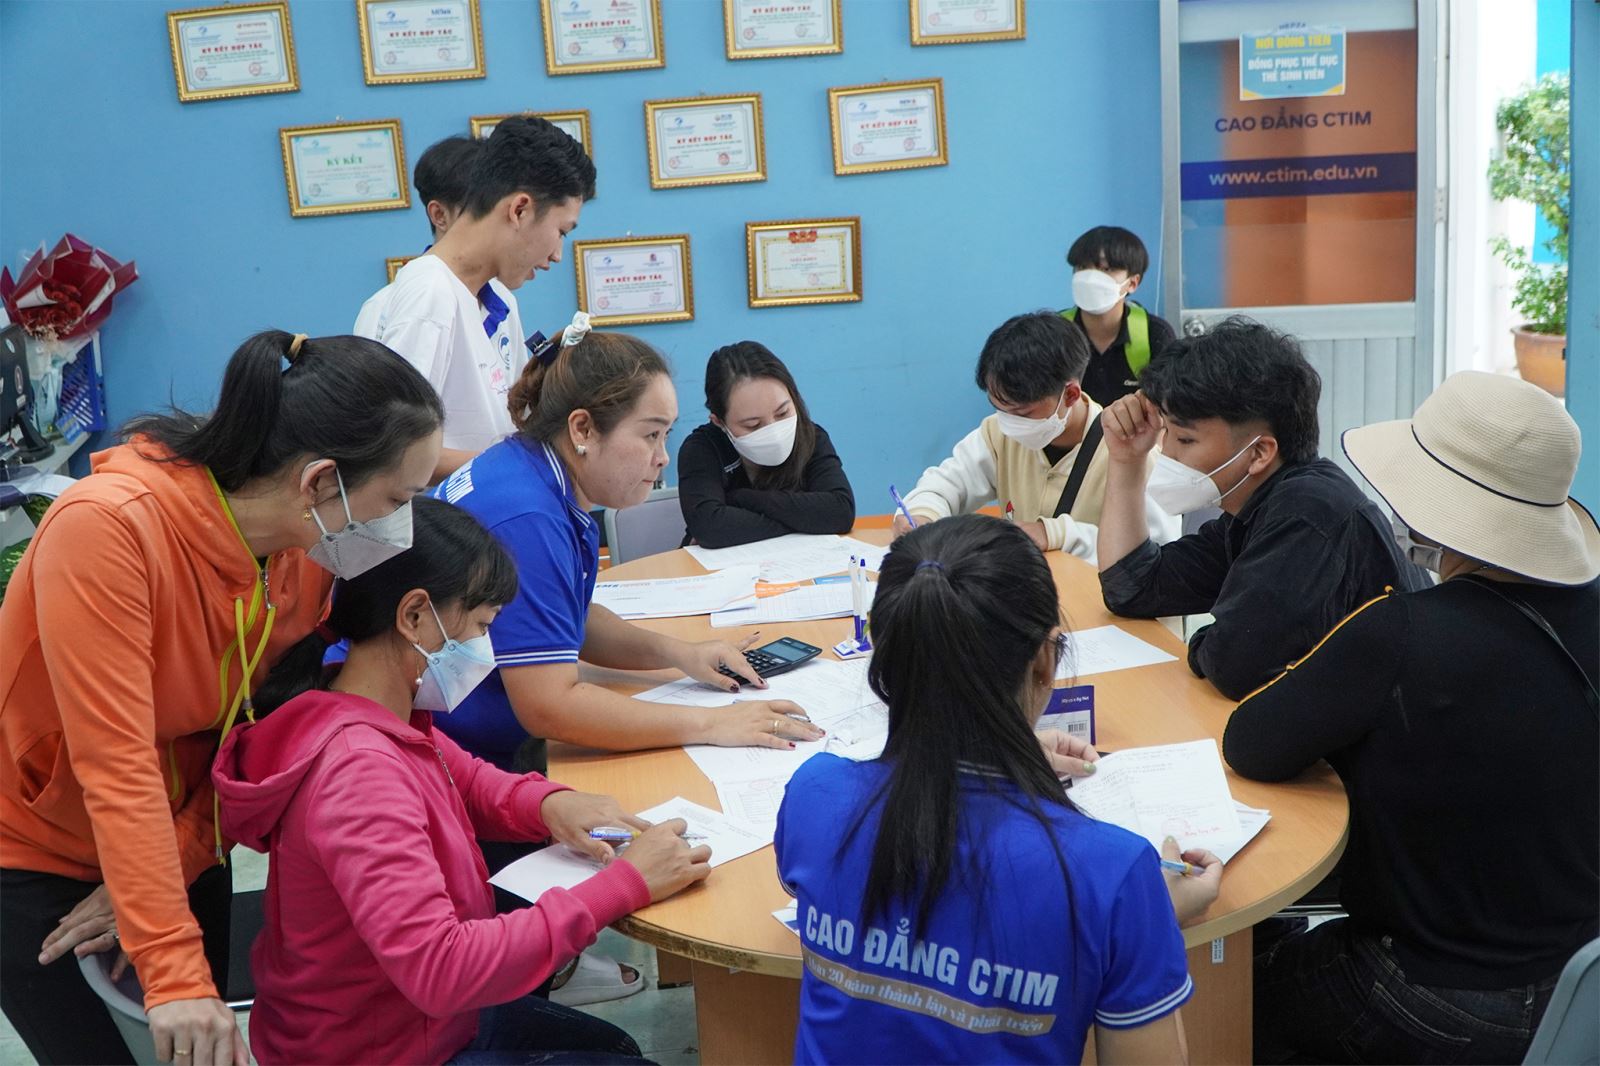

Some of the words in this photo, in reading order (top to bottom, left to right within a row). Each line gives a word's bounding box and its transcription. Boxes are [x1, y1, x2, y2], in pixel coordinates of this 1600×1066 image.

[1215, 117, 1256, 133] CAO
[1261, 106, 1318, 131] ĐẲNG
[1323, 111, 1372, 128] CTIM
[1209, 164, 1378, 186] www.ctim.edu.vn
[805, 905, 855, 956] CAO
[863, 917, 960, 986] ĐẲNG
[968, 957, 1059, 1007] CTIM
[827, 967, 844, 983] 20
[844, 979, 876, 995] năm
[878, 984, 923, 1007] thành
